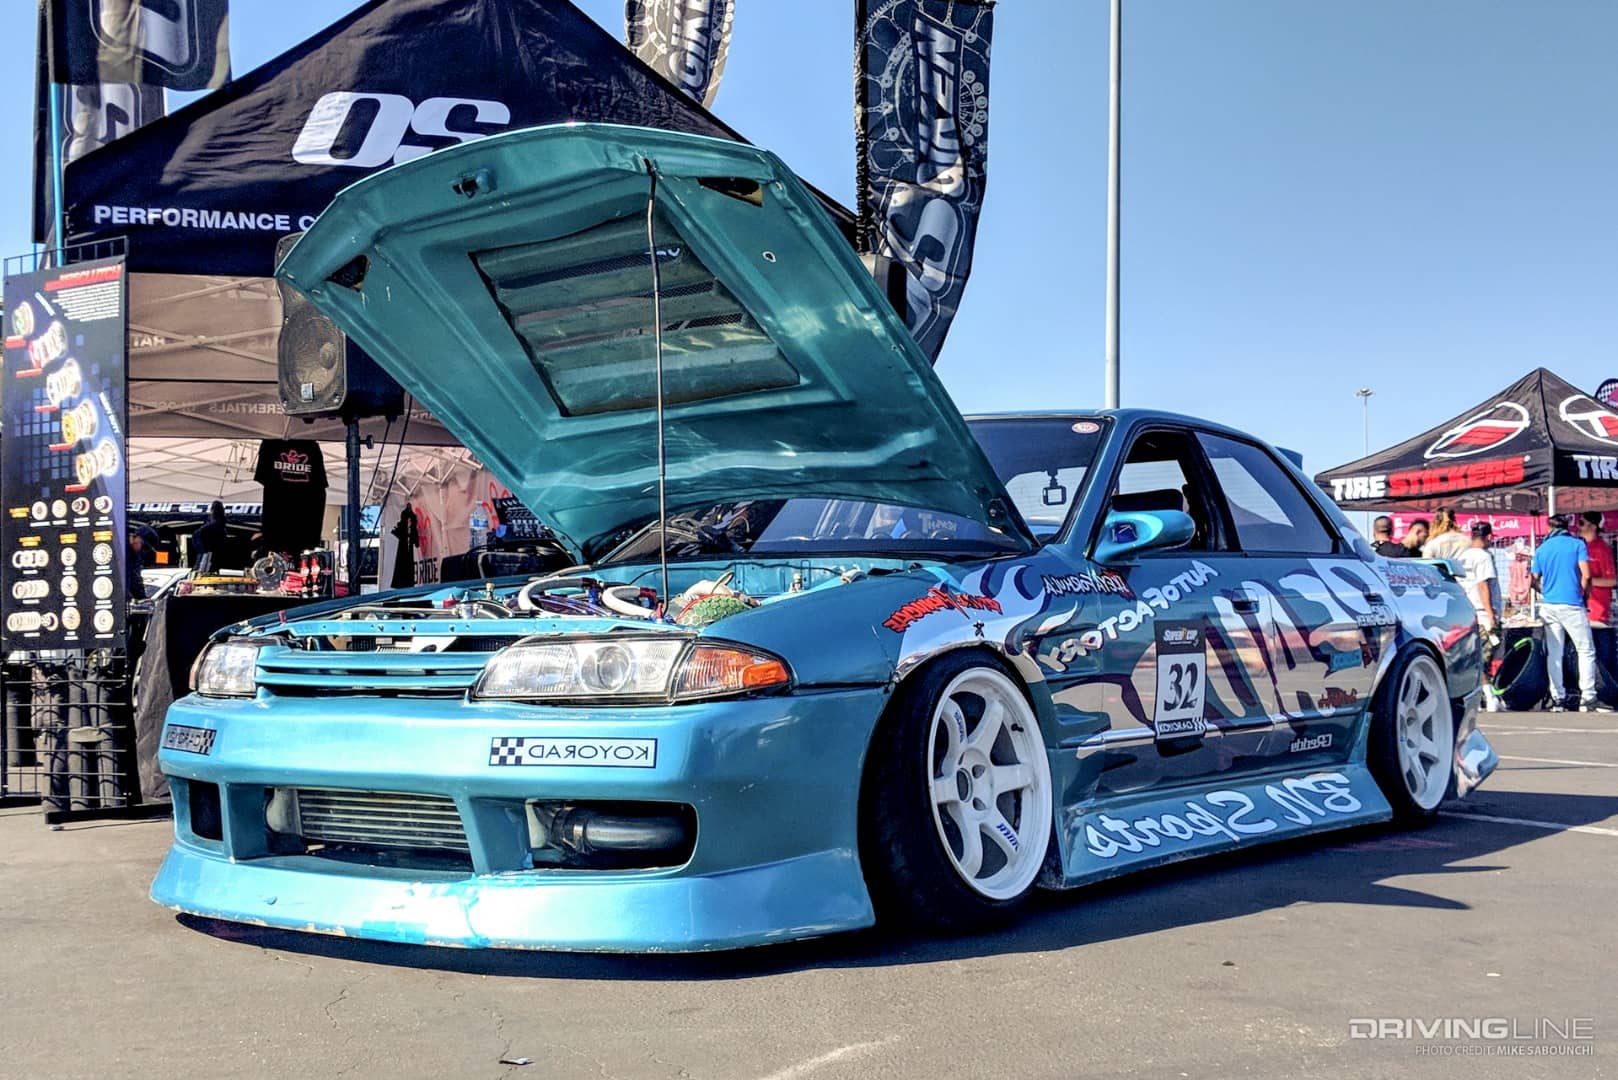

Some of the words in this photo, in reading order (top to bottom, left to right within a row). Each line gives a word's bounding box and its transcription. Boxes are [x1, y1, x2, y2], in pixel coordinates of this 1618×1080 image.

[291, 91, 512, 168] OS
[94, 205, 290, 231] PERFORMANCE
[274, 461, 313, 473] BRIDE
[1329, 474, 1387, 501] TIRE
[1388, 456, 1525, 497] STICKERS
[1573, 455, 1618, 480] TIR
[413, 558, 439, 585] BRIDE
[1163, 662, 1198, 712] 32
